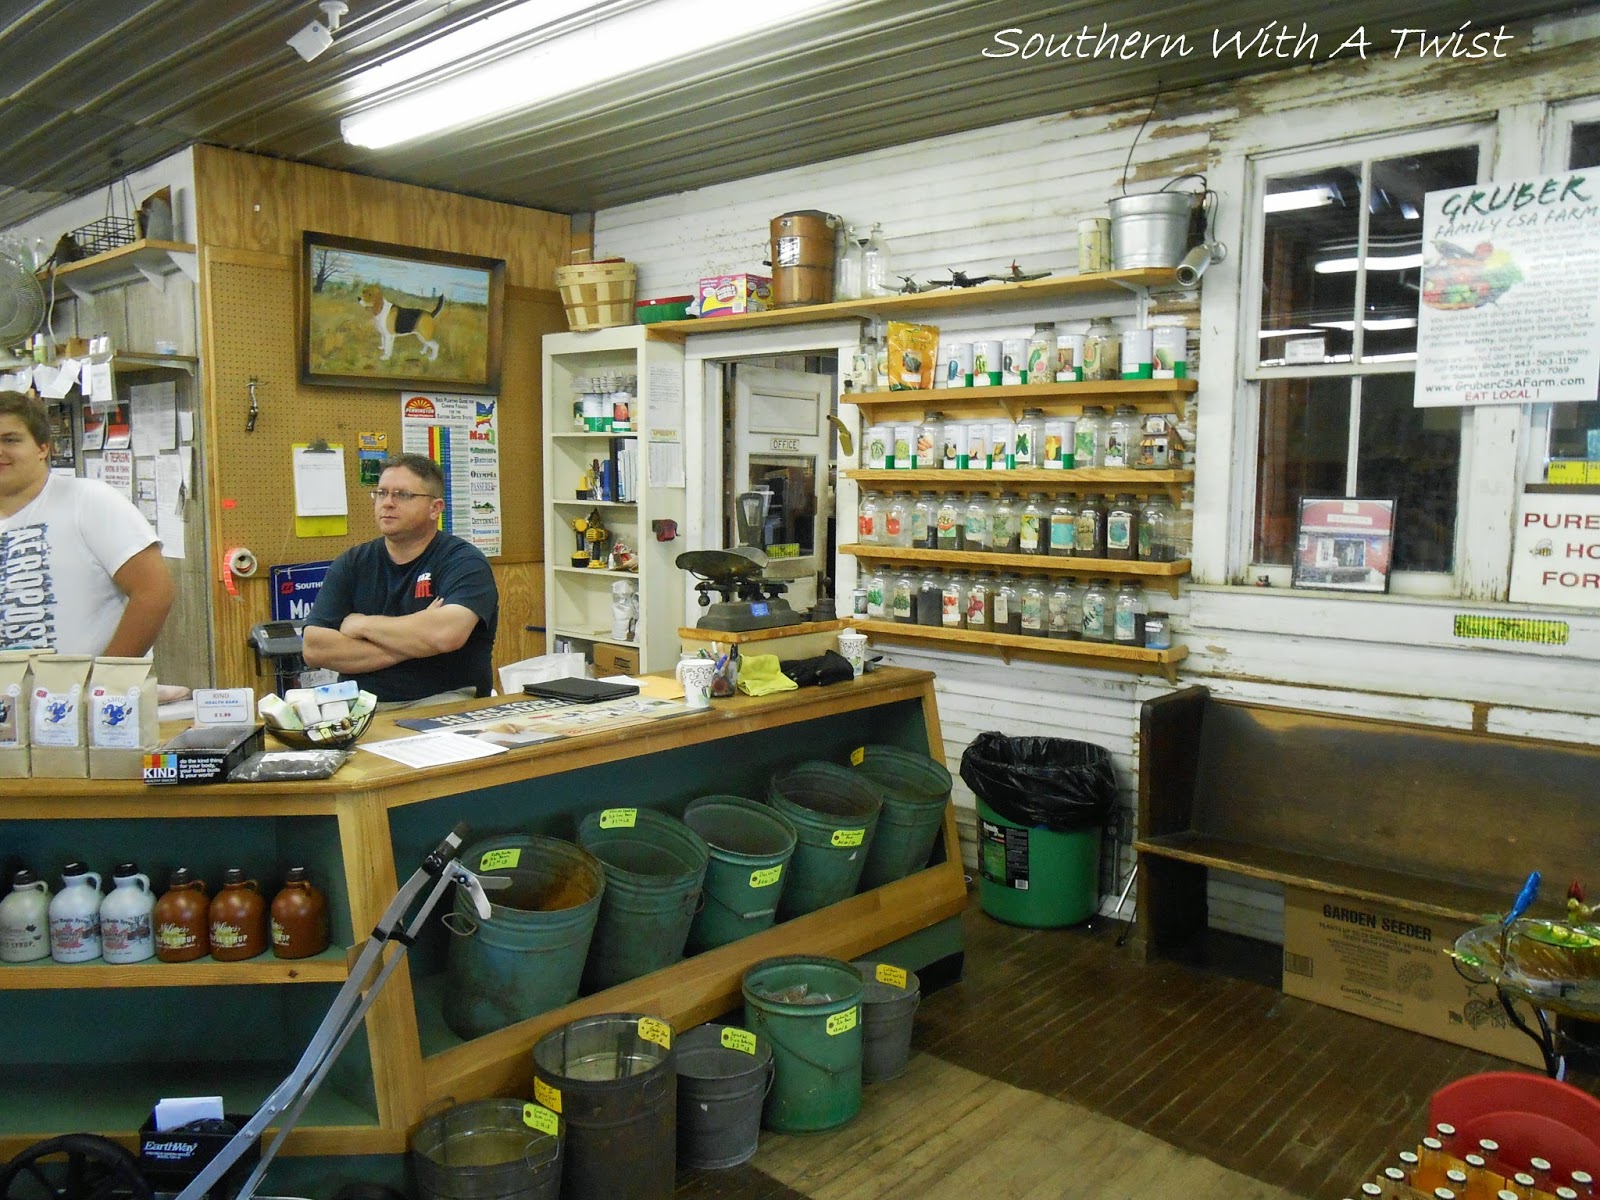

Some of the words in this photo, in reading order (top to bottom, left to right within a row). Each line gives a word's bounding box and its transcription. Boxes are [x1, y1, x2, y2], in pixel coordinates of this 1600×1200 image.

[1441, 175, 1592, 220] GRUBER
[1435, 217, 1501, 239] FAMILY
[1506, 212, 1538, 228] CSA
[1544, 205, 1598, 225] FARM
[1425, 376, 1586, 393] www.GruberCSAFarm.com
[1465, 391, 1488, 401] EAT
[1493, 389, 1531, 400] LOCAL
[773, 440, 797, 450] OFFICE
[1524, 513, 1600, 530] PURE
[1542, 571, 1600, 589] FOR
[290, 599, 314, 620] MA
[143, 768, 177, 778] KIND
[1323, 904, 1376, 929] GARDEN
[1381, 917, 1432, 942] SEEDER
[144, 1141, 197, 1153] EarthWay
